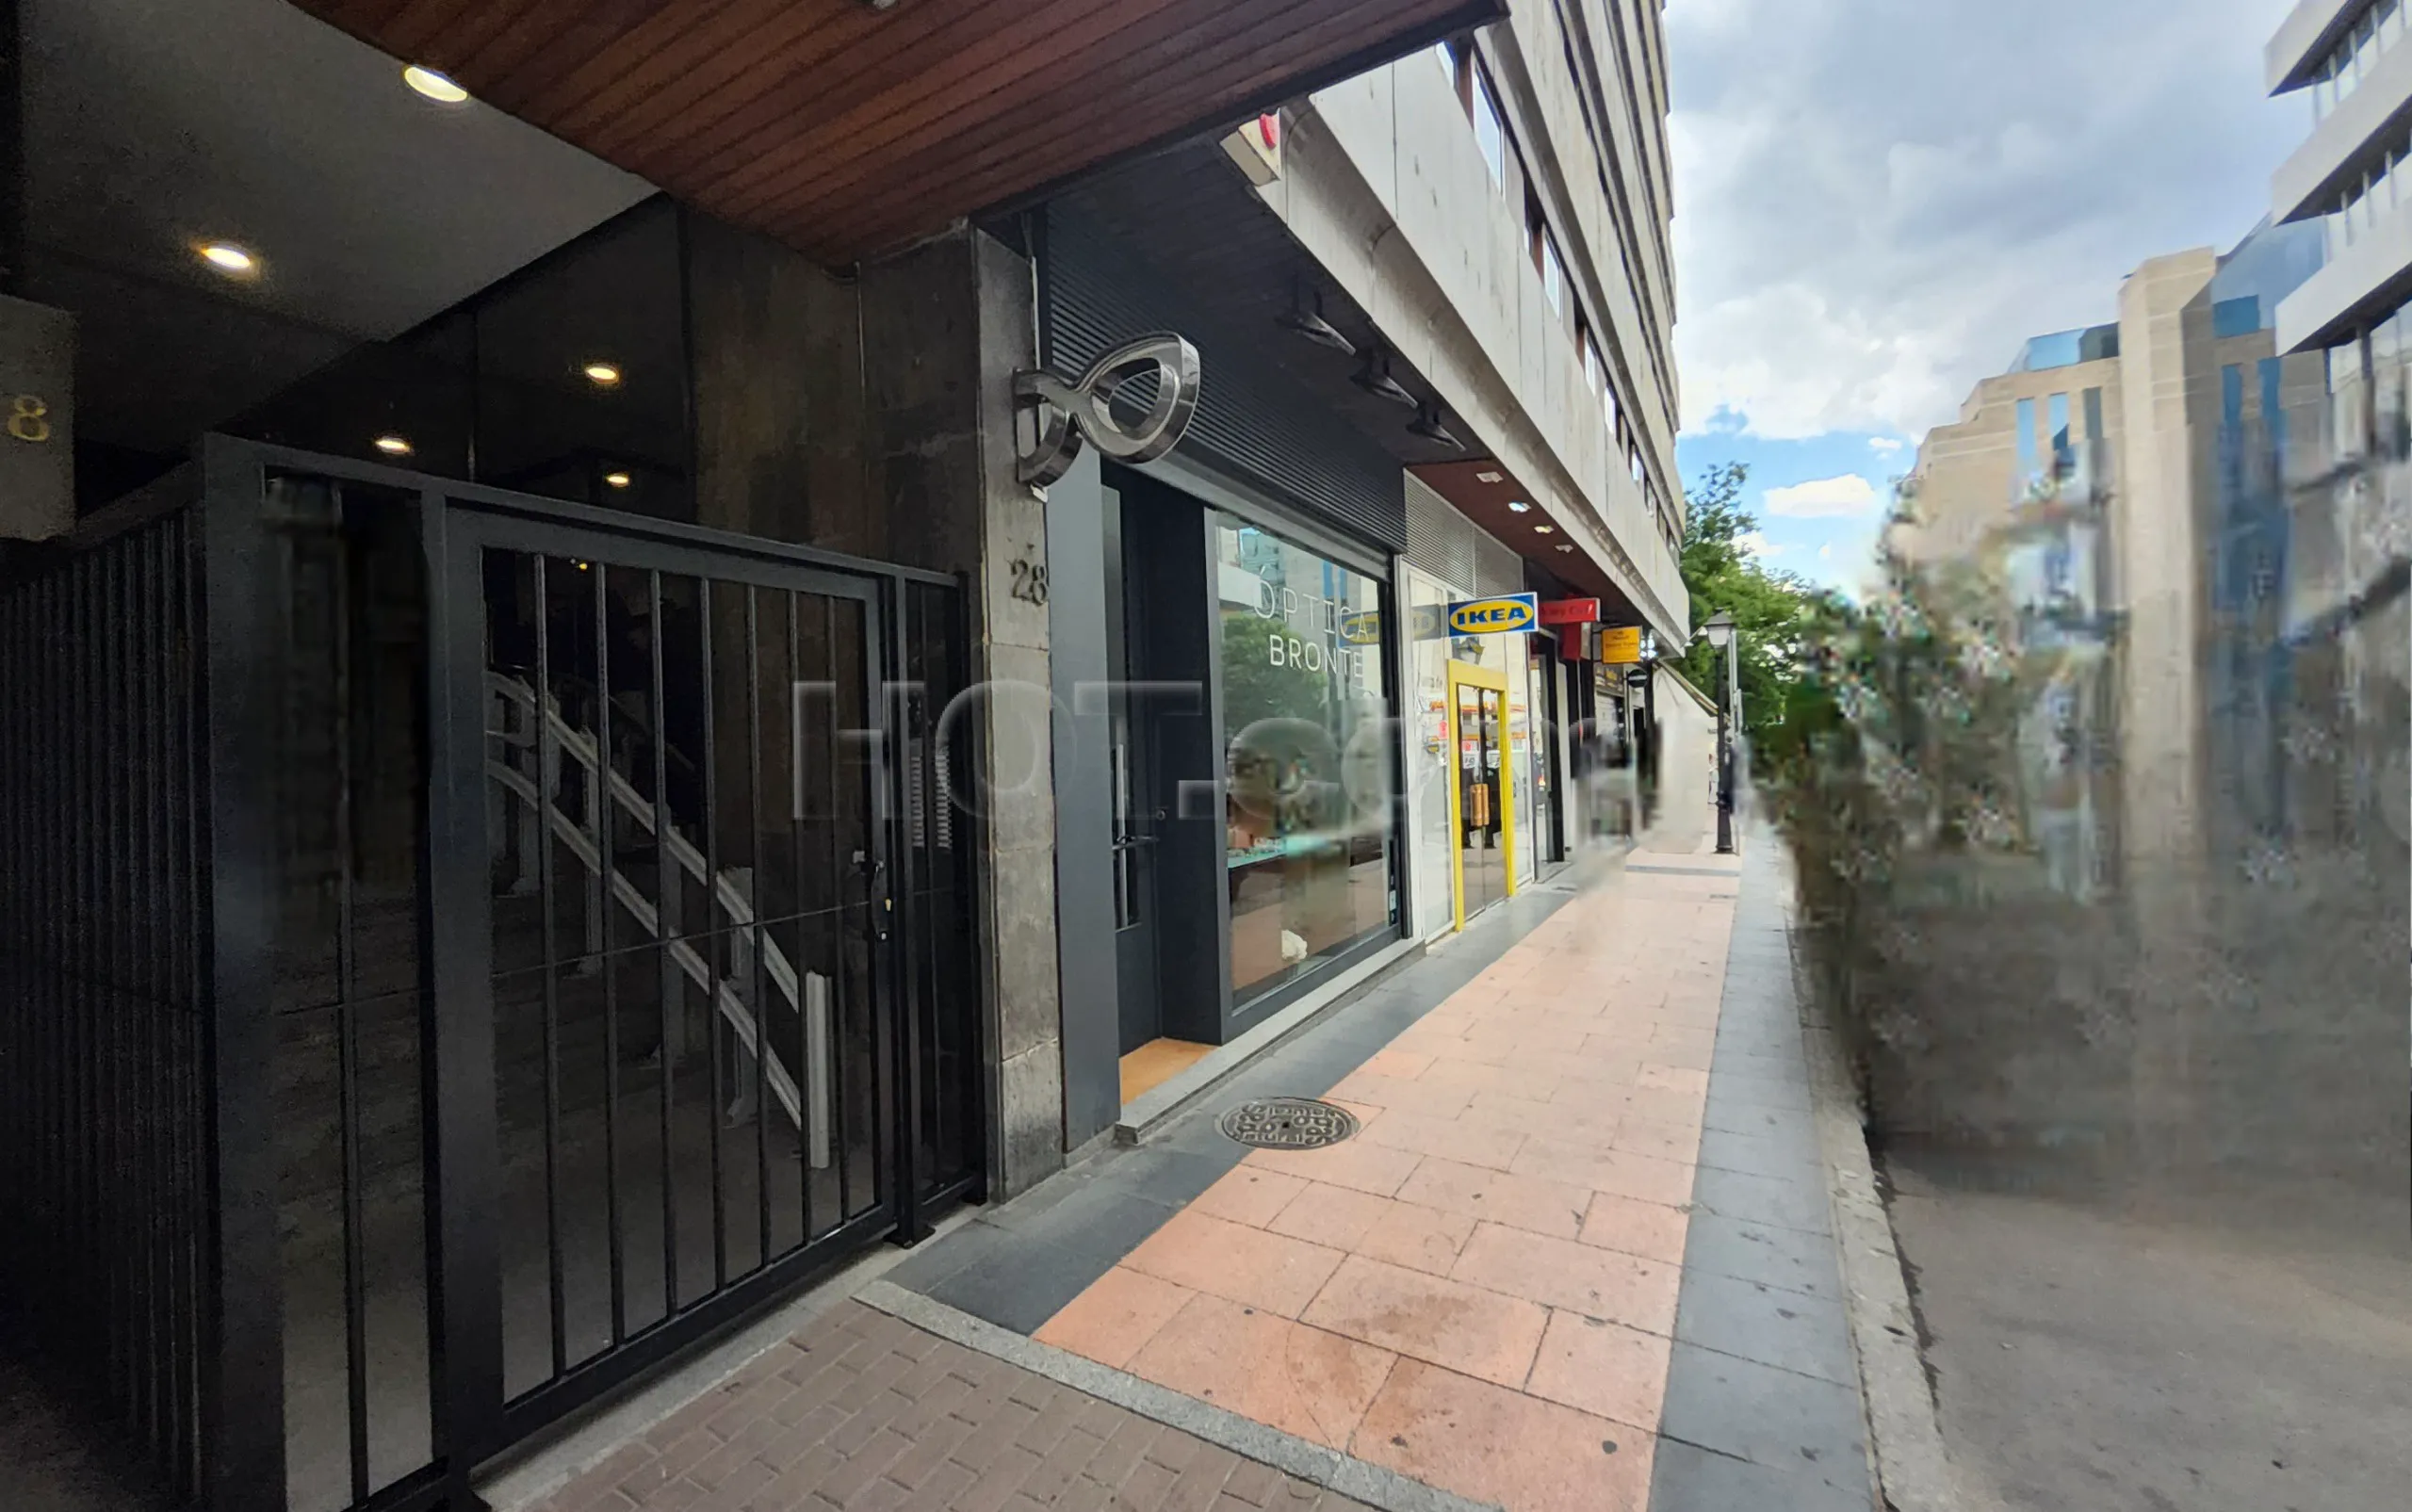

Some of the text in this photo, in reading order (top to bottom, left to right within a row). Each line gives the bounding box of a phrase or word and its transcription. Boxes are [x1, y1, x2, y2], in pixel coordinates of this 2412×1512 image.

[1010, 558, 1047, 607] 28
[1457, 607, 1526, 625] IKEA
[1269, 634, 1364, 678] BRONTE
